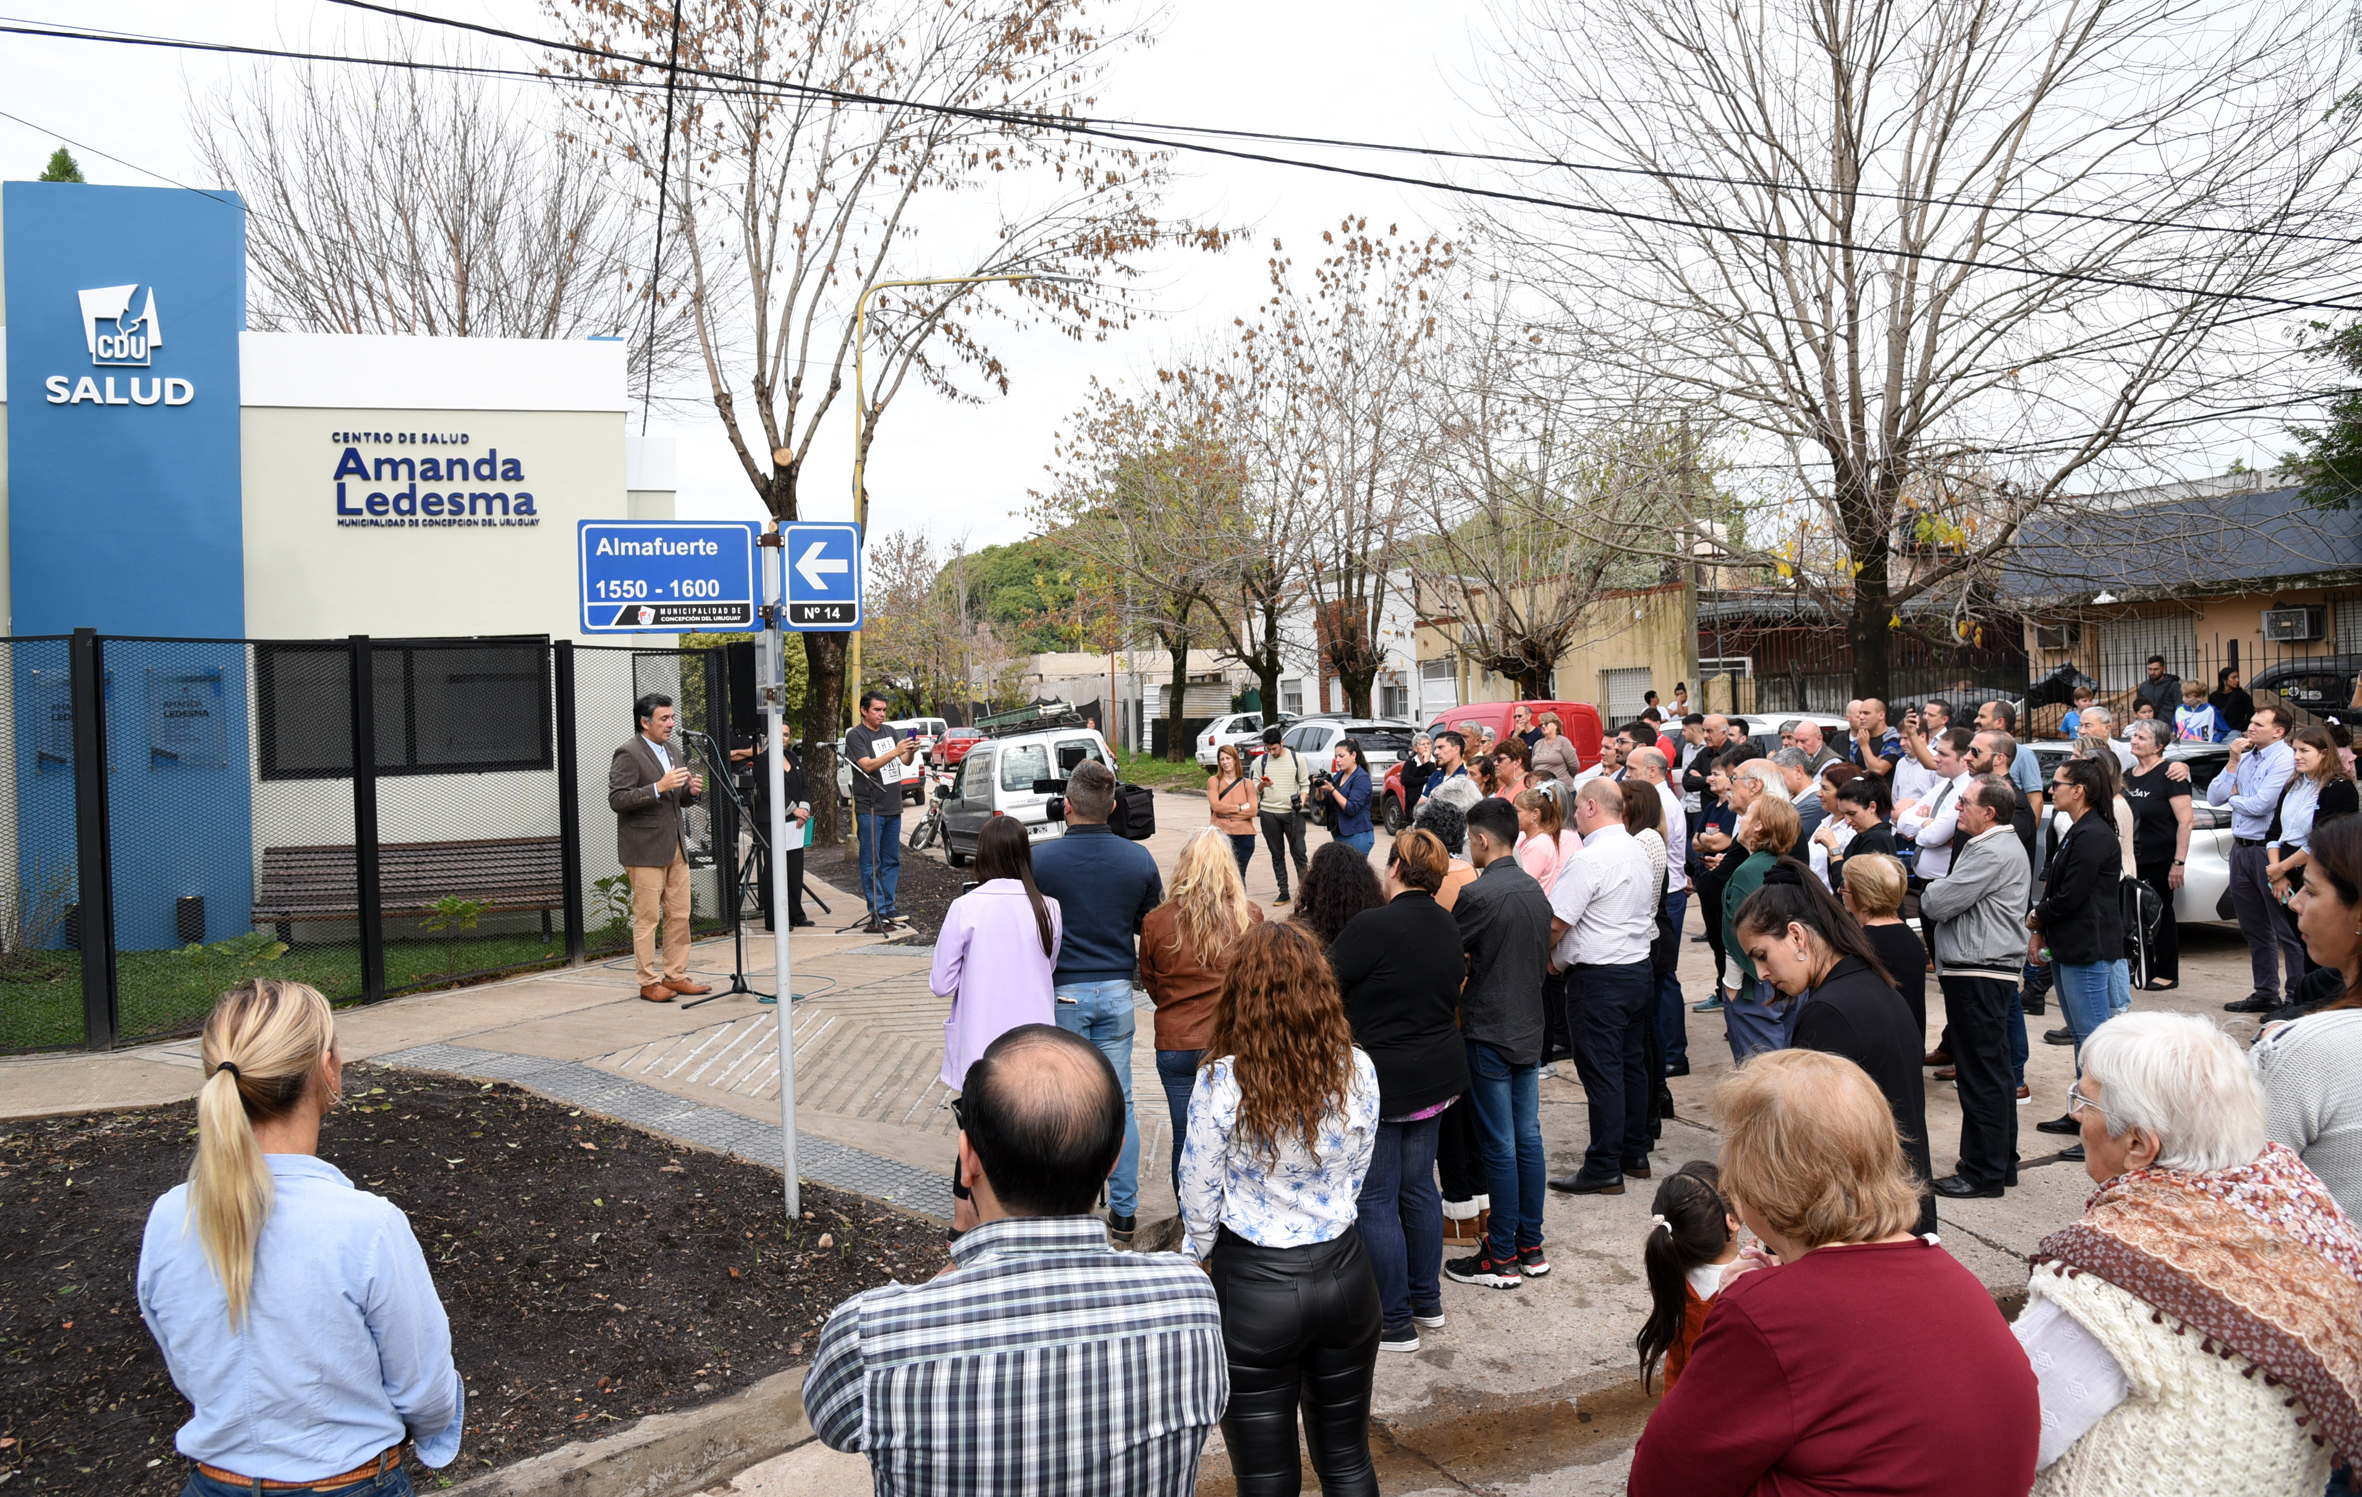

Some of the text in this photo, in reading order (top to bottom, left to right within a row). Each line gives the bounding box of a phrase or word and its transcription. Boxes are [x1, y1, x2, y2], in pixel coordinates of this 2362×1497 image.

[97, 335, 146, 359] CDU
[45, 375, 195, 406] SALUD
[332, 432, 470, 444] CENTRO DE SALUD
[334, 447, 525, 481] Amanda
[336, 482, 537, 516] Ledesma
[337, 518, 540, 527] MUNICIPALIDAD DE CONCEPCION DEL URUGUAY
[596, 537, 718, 556] Almafuerte
[596, 579, 648, 599] 1550
[669, 579, 720, 598] 1600
[660, 607, 728, 615] MUNICIPALIDAD
[824, 606, 841, 619] 14
